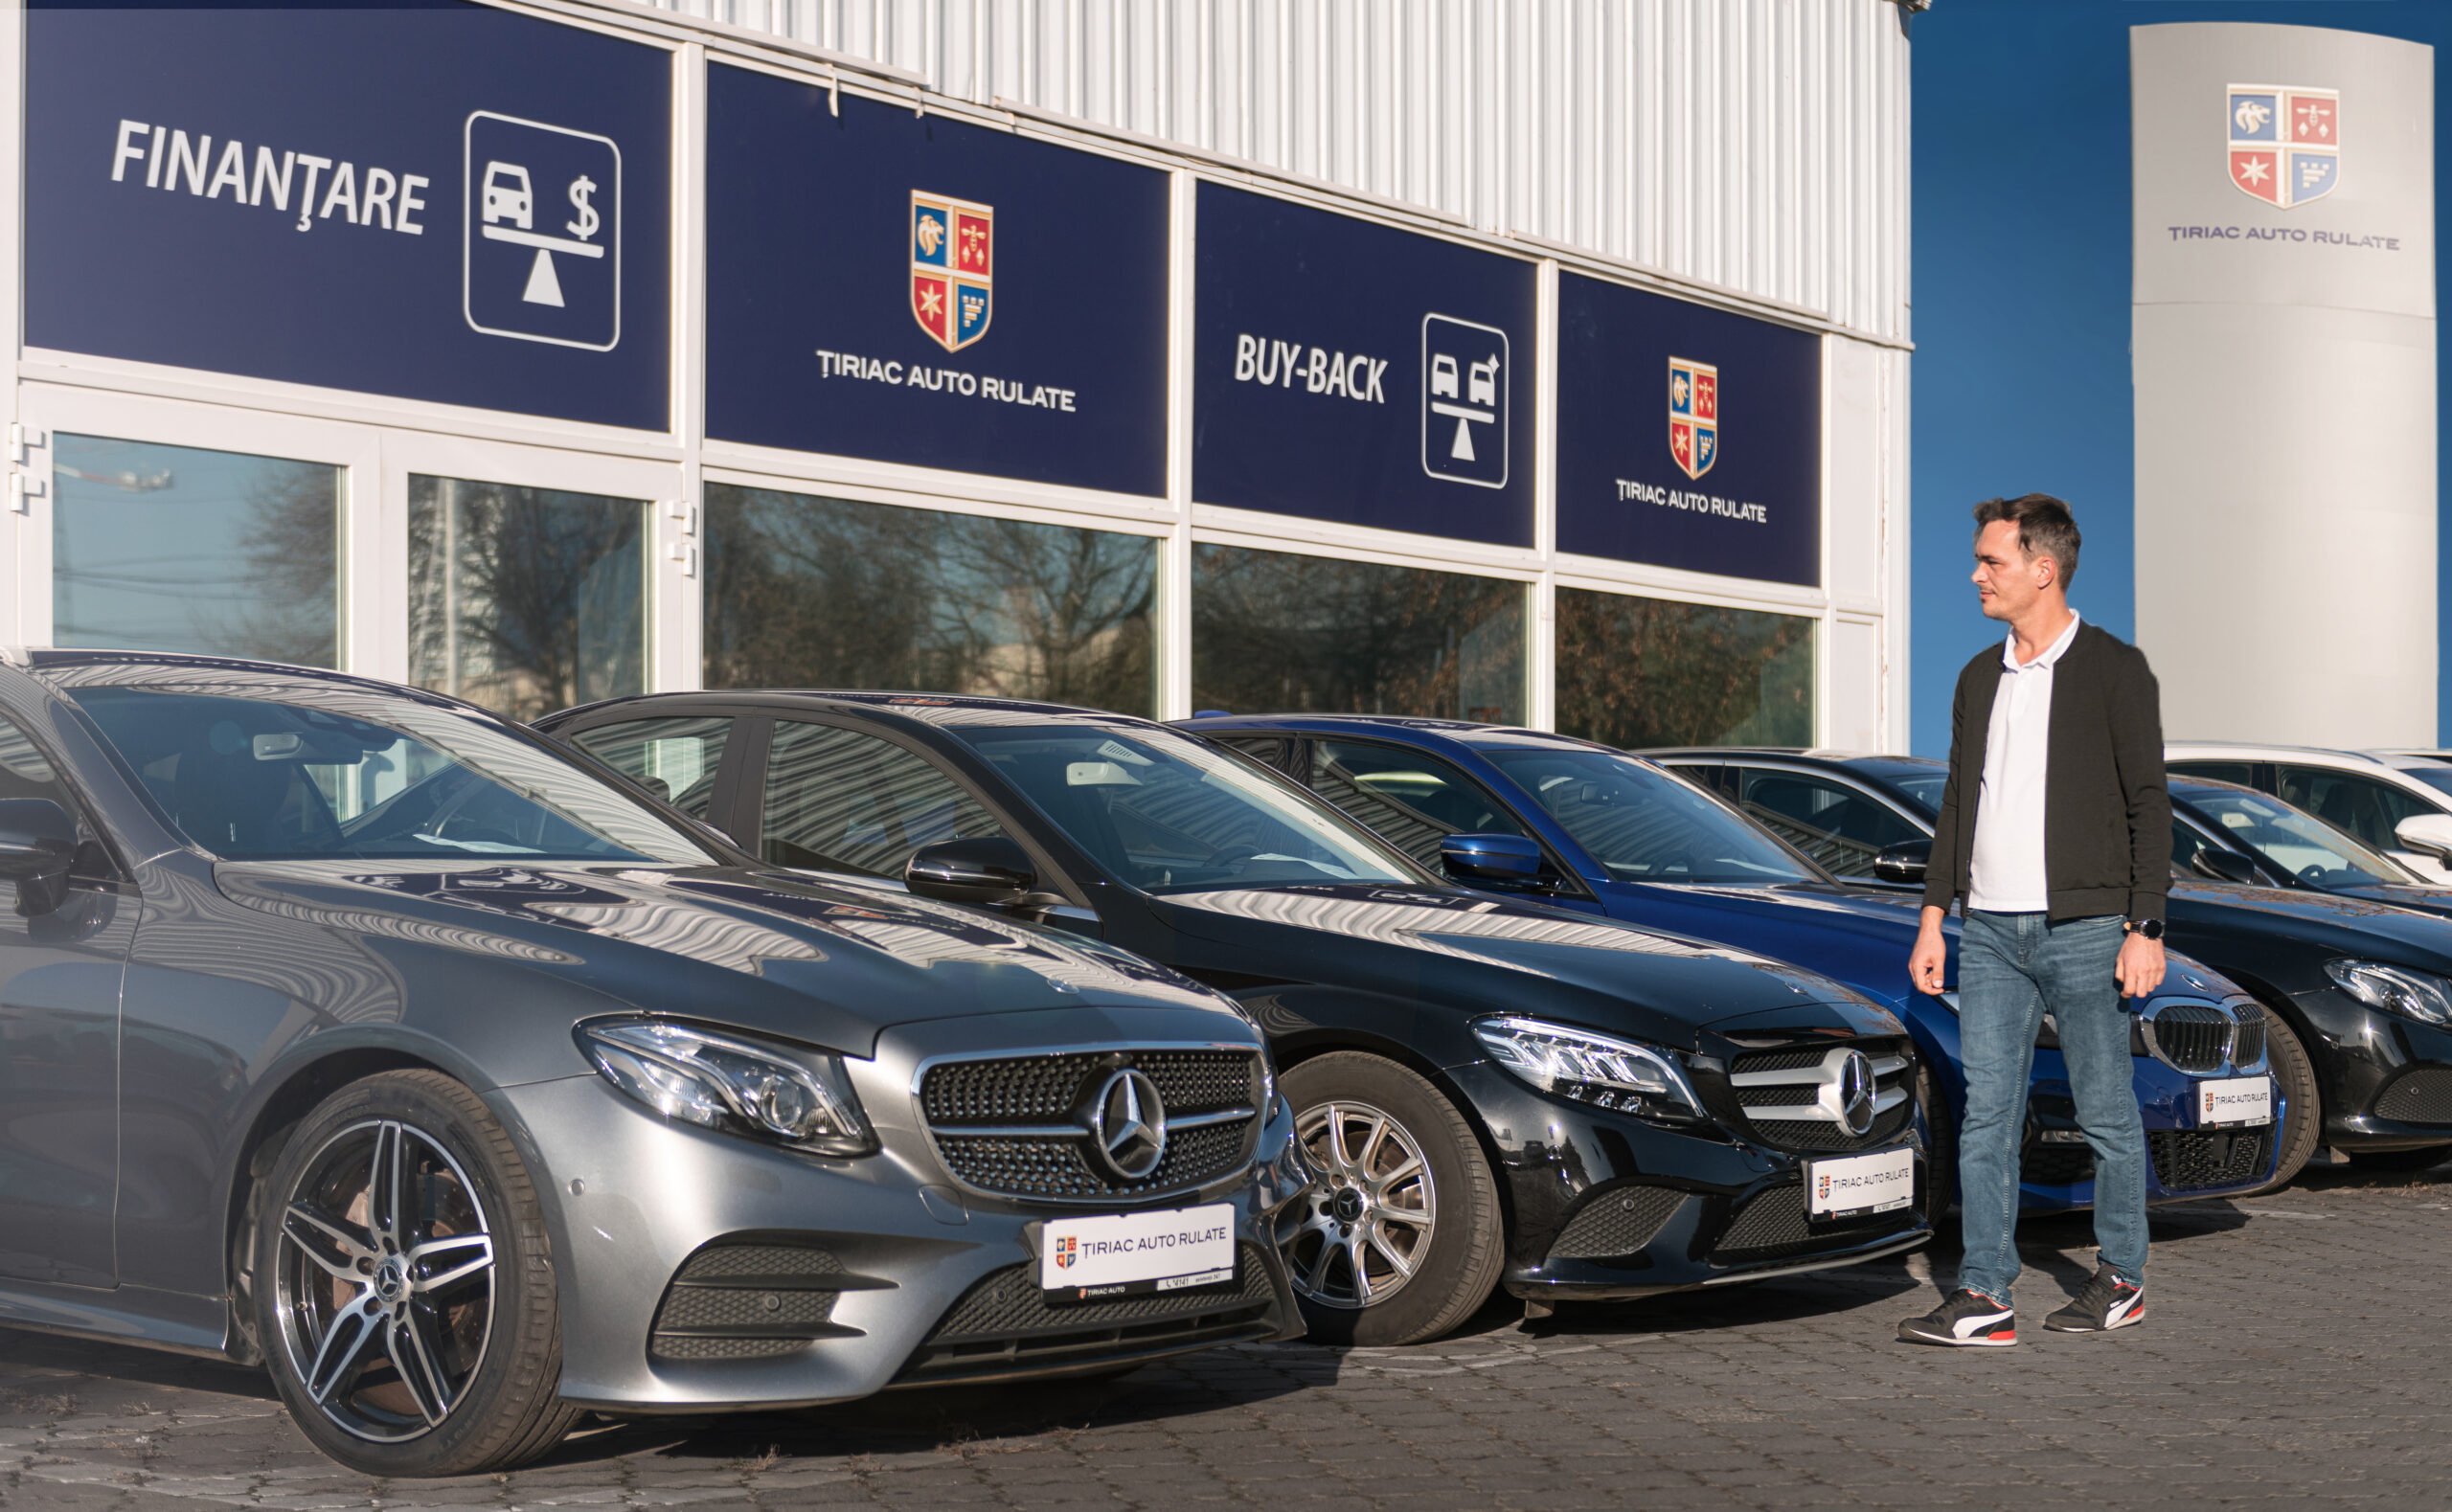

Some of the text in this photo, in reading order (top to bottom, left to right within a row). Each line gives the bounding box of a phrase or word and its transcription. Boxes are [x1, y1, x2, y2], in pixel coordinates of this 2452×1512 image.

[2245, 227, 2307, 242] AUTO
[2313, 231, 2400, 251] RULATE
[1235, 333, 1388, 404] BUY-BACK
[907, 365, 977, 396] AUTO
[981, 376, 1077, 413] RULATE
[1669, 489, 1709, 513] AUTO
[1711, 496, 1767, 524] RULATE
[2236, 1094, 2251, 1103] AUTO
[2252, 1092, 2268, 1102] RULATE
[1864, 1173, 1884, 1185] AUTO
[1885, 1167, 1909, 1182] RULATE
[1138, 1234, 1176, 1251] AUTO
[1179, 1227, 1227, 1246] RULATE
